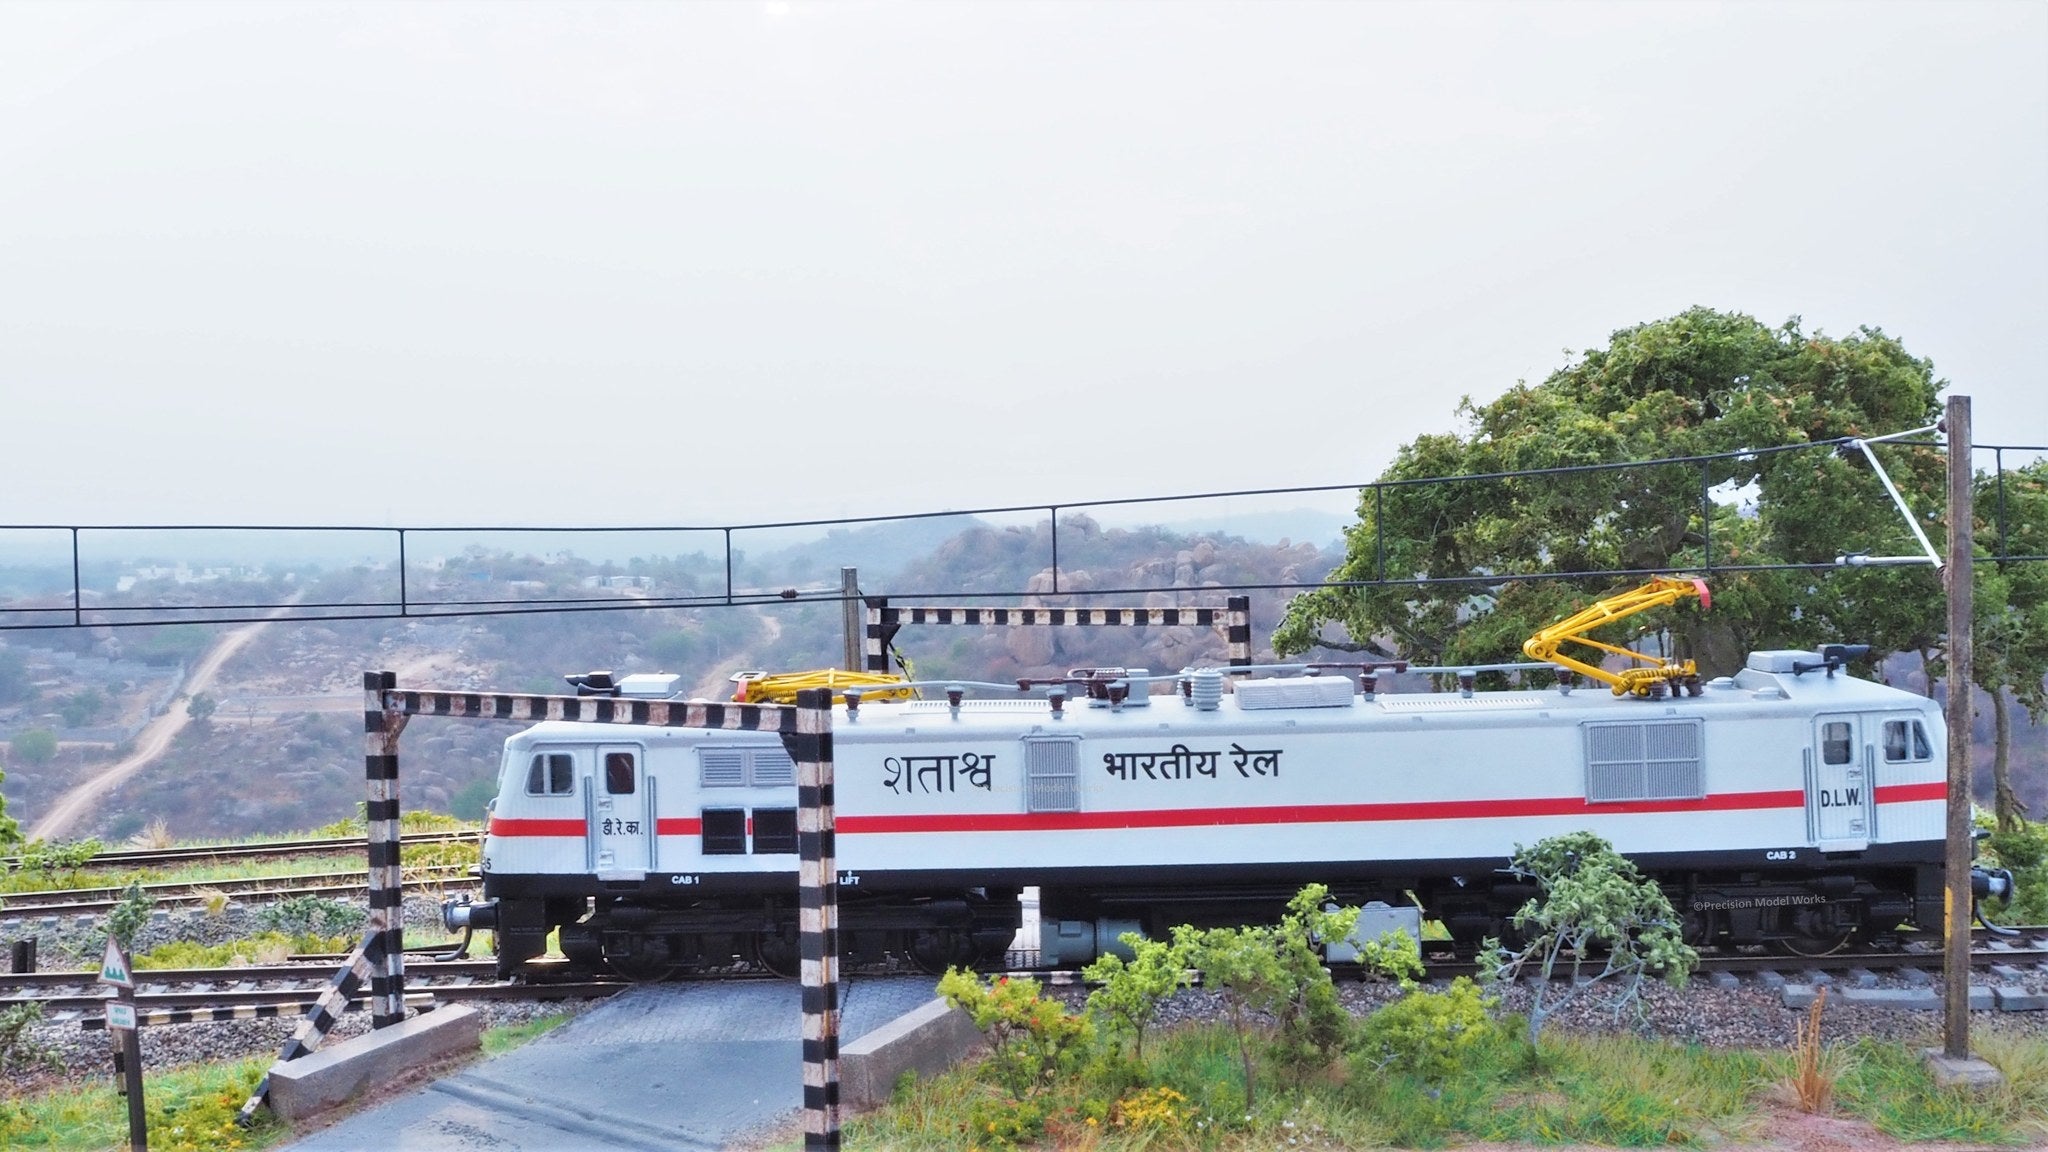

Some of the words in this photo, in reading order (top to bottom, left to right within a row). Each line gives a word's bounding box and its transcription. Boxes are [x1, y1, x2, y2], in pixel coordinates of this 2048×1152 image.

[1103, 743, 1222, 781] भारतीय
[1230, 742, 1284, 778] रेल
[883, 752, 996, 795] शताश्व
[1821, 788, 1862, 808] D.L.W.
[602, 818, 643, 836] डी.रे.का.
[1766, 851, 1788, 860] CAB
[1789, 850, 1796, 860] 2
[671, 876, 692, 884] CAB
[694, 876, 700, 884] 1
